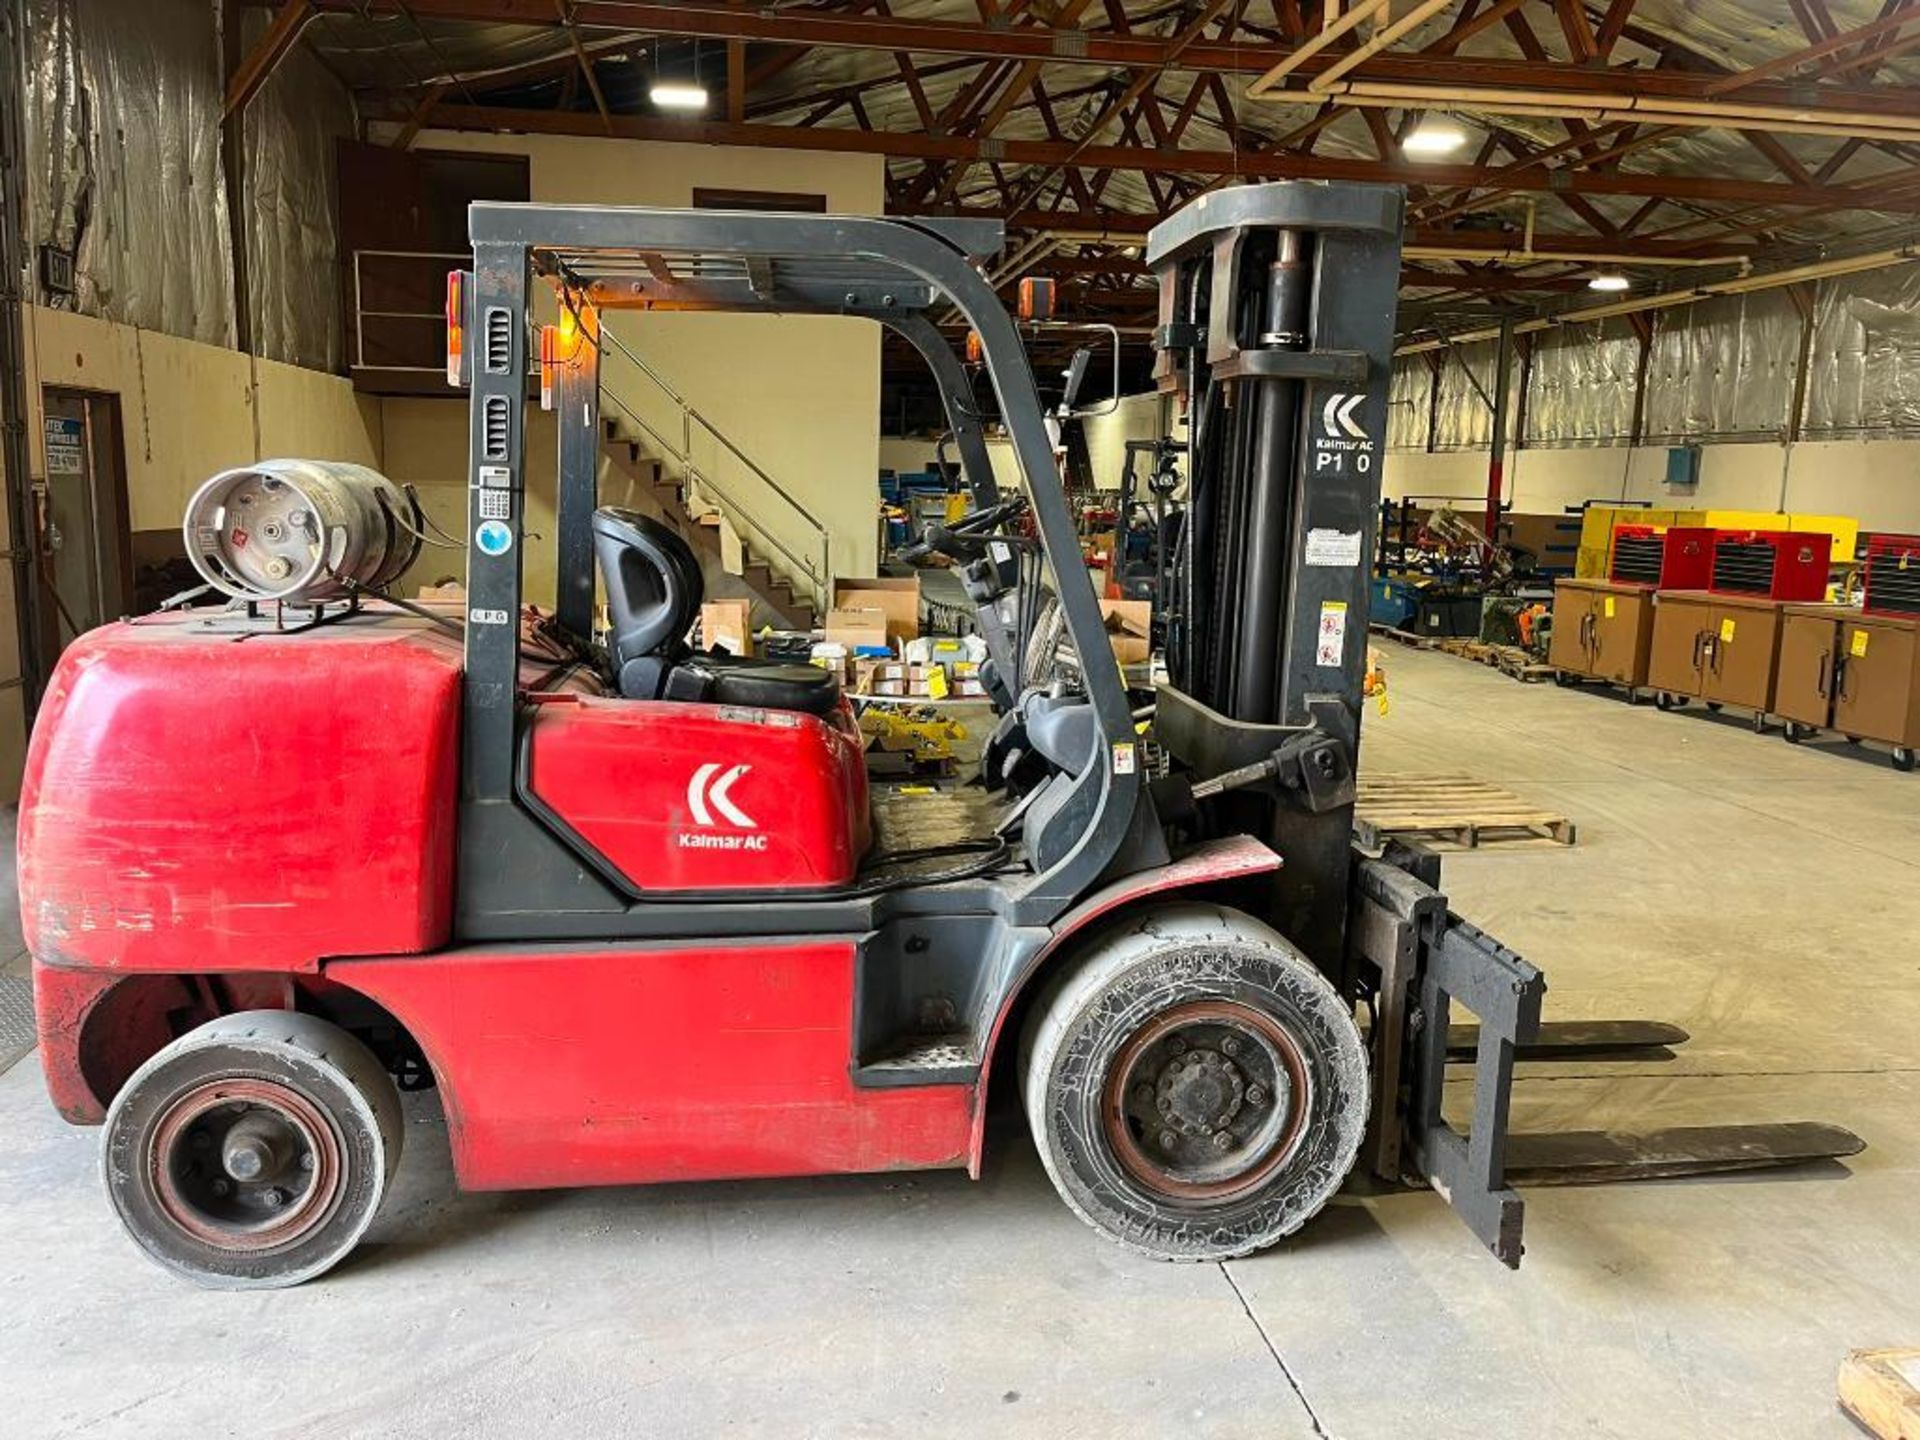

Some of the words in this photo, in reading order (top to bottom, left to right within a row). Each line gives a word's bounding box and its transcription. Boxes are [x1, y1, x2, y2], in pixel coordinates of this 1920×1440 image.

[1316, 438, 1358, 450] Kalmar
[1359, 441, 1374, 451] AC
[679, 834, 743, 848] Kalmar
[743, 836, 768, 850] AC
